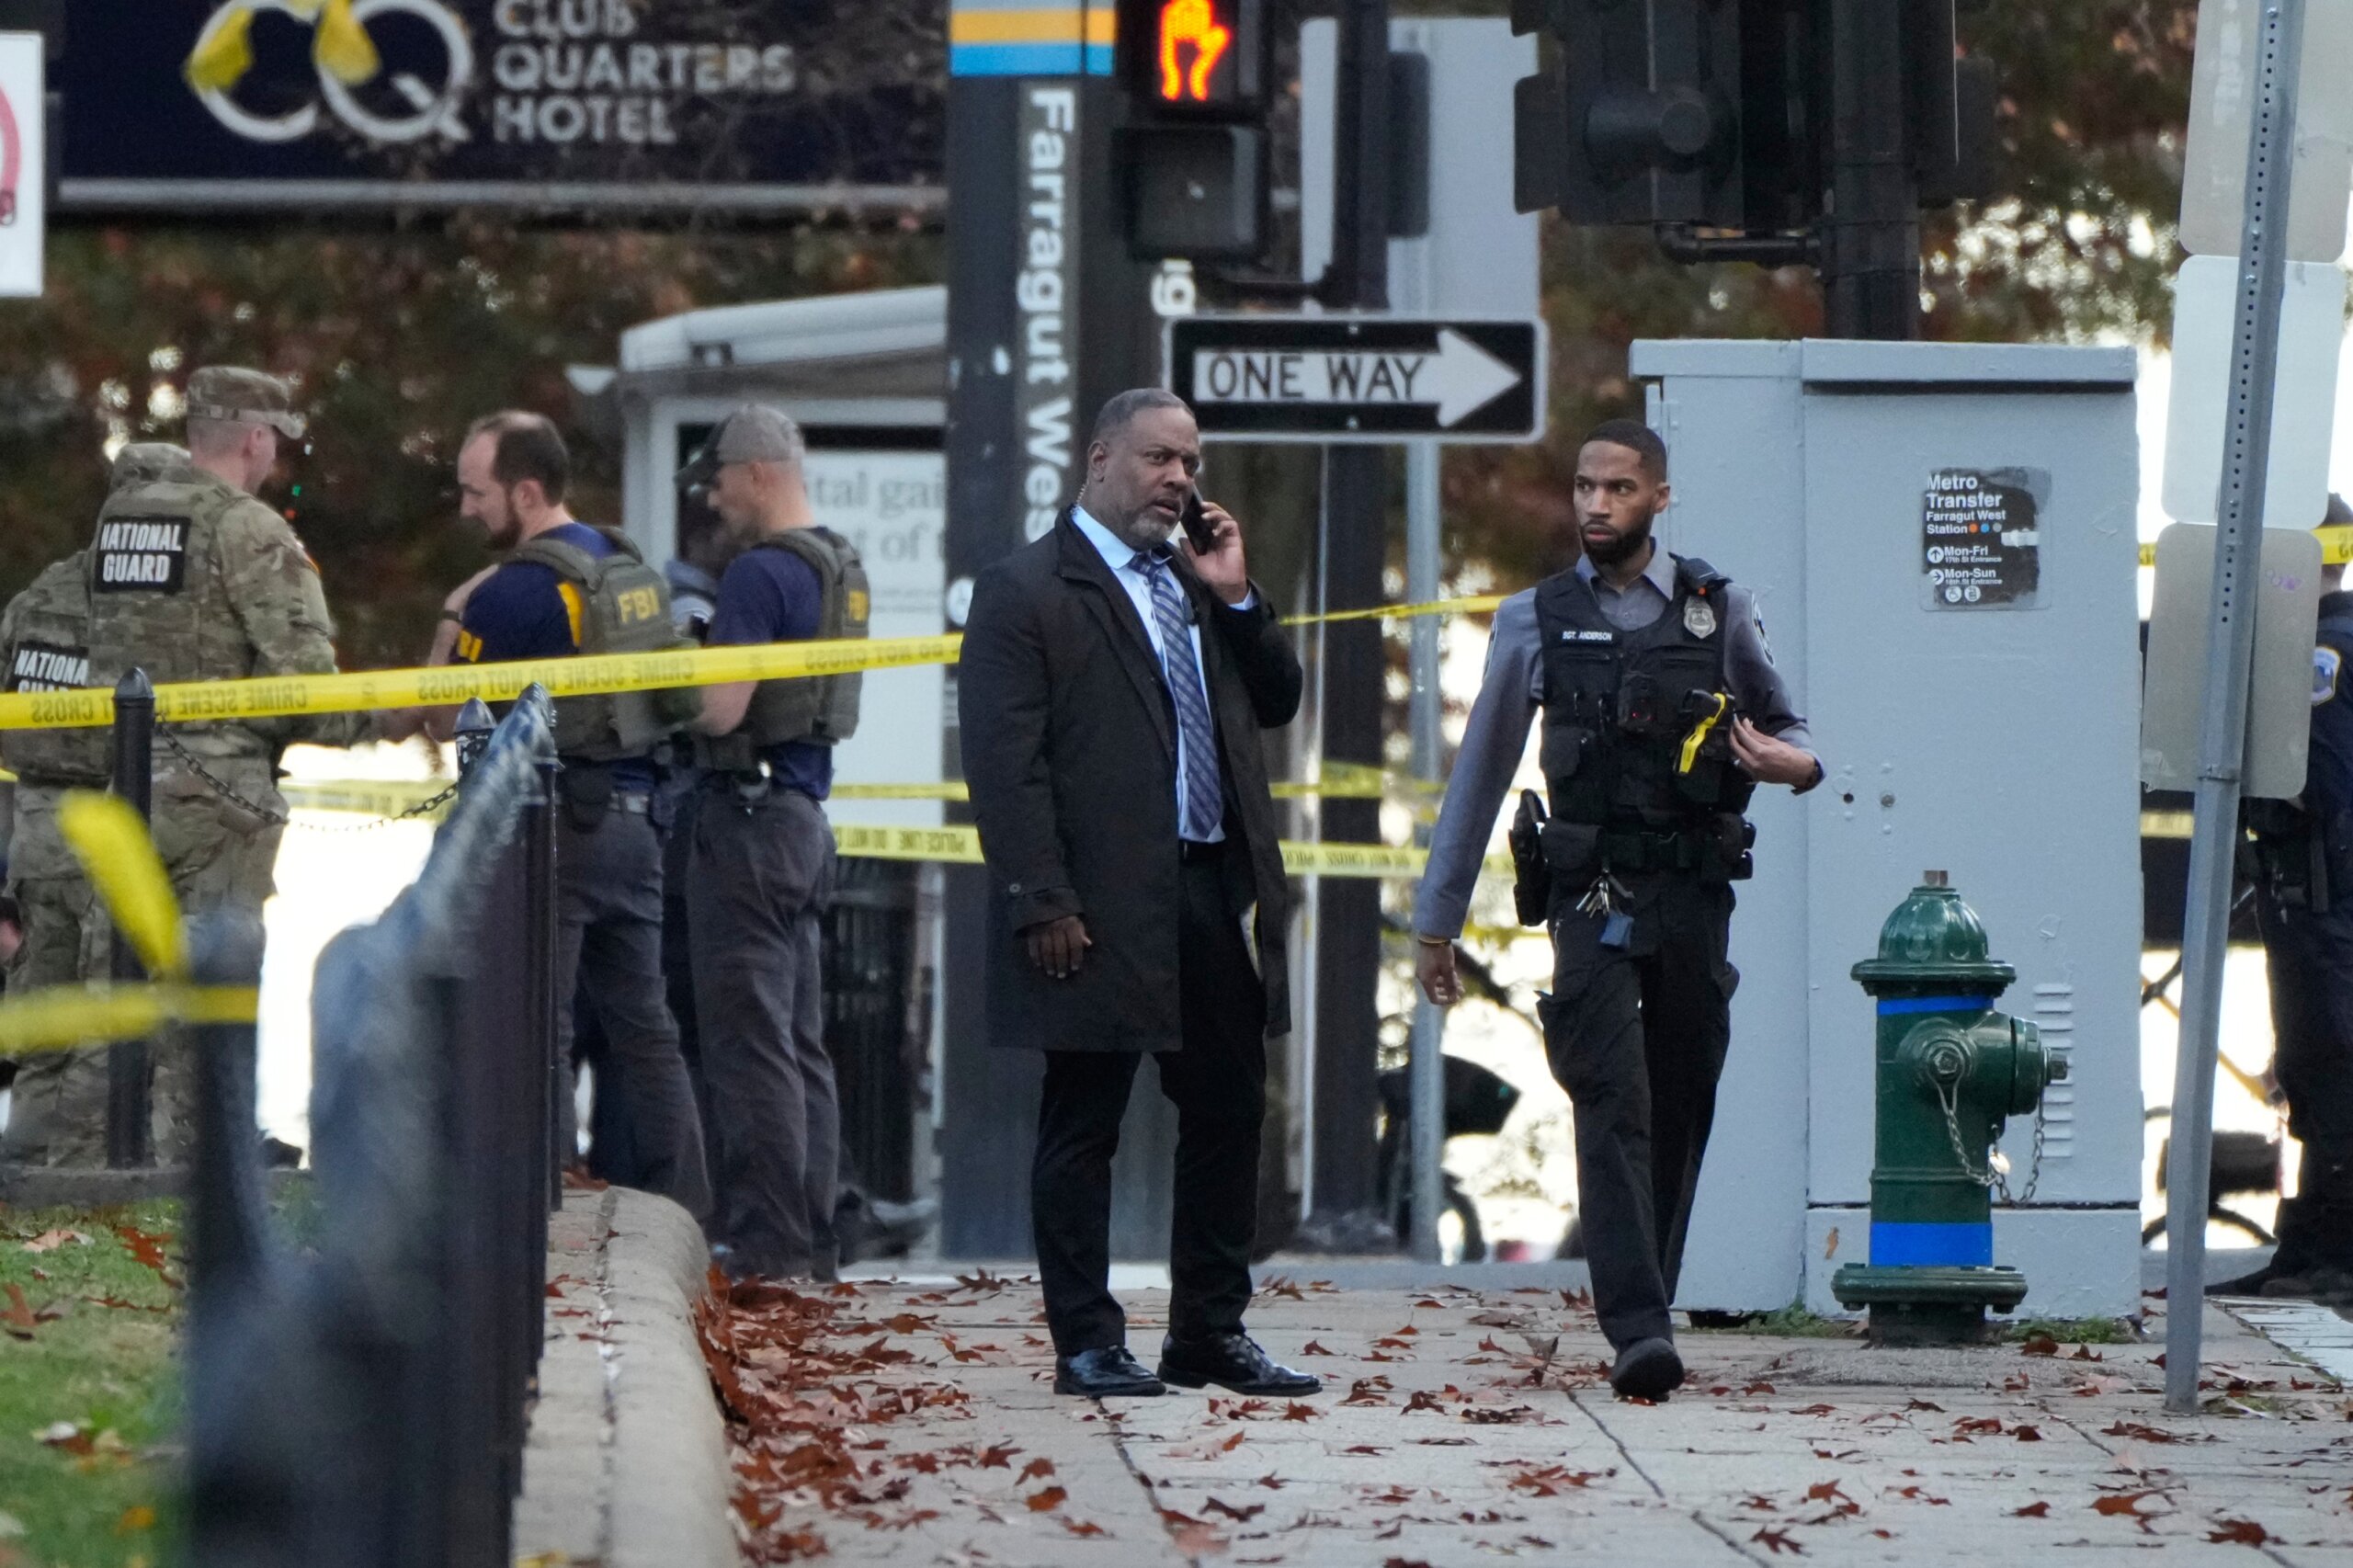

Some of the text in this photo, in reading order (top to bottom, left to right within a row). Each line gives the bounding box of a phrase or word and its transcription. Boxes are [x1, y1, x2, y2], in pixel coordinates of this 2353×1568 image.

[494, 0, 636, 37] CLUB
[494, 42, 794, 92] QUARTERS
[494, 95, 677, 142] HOTEL
[1017, 88, 1075, 544] Farragut Wes
[1208, 353, 1425, 401] ONE WAY
[1927, 474, 1978, 491] Metro
[1927, 492, 2003, 508] Transfer
[1927, 509, 2006, 523] Farragut West
[1927, 523, 1968, 535] Station
[100, 522, 183, 551] NATIONAL
[1944, 545, 1989, 557] Mon-Fri
[102, 553, 172, 583] GUARD
[1944, 567, 1996, 579] Mon-Sun
[617, 585, 659, 624] FBI
[458, 629, 483, 663] BI
[1563, 631, 1612, 641] SGT. ANDERSON
[14, 649, 89, 687] NATIONA
